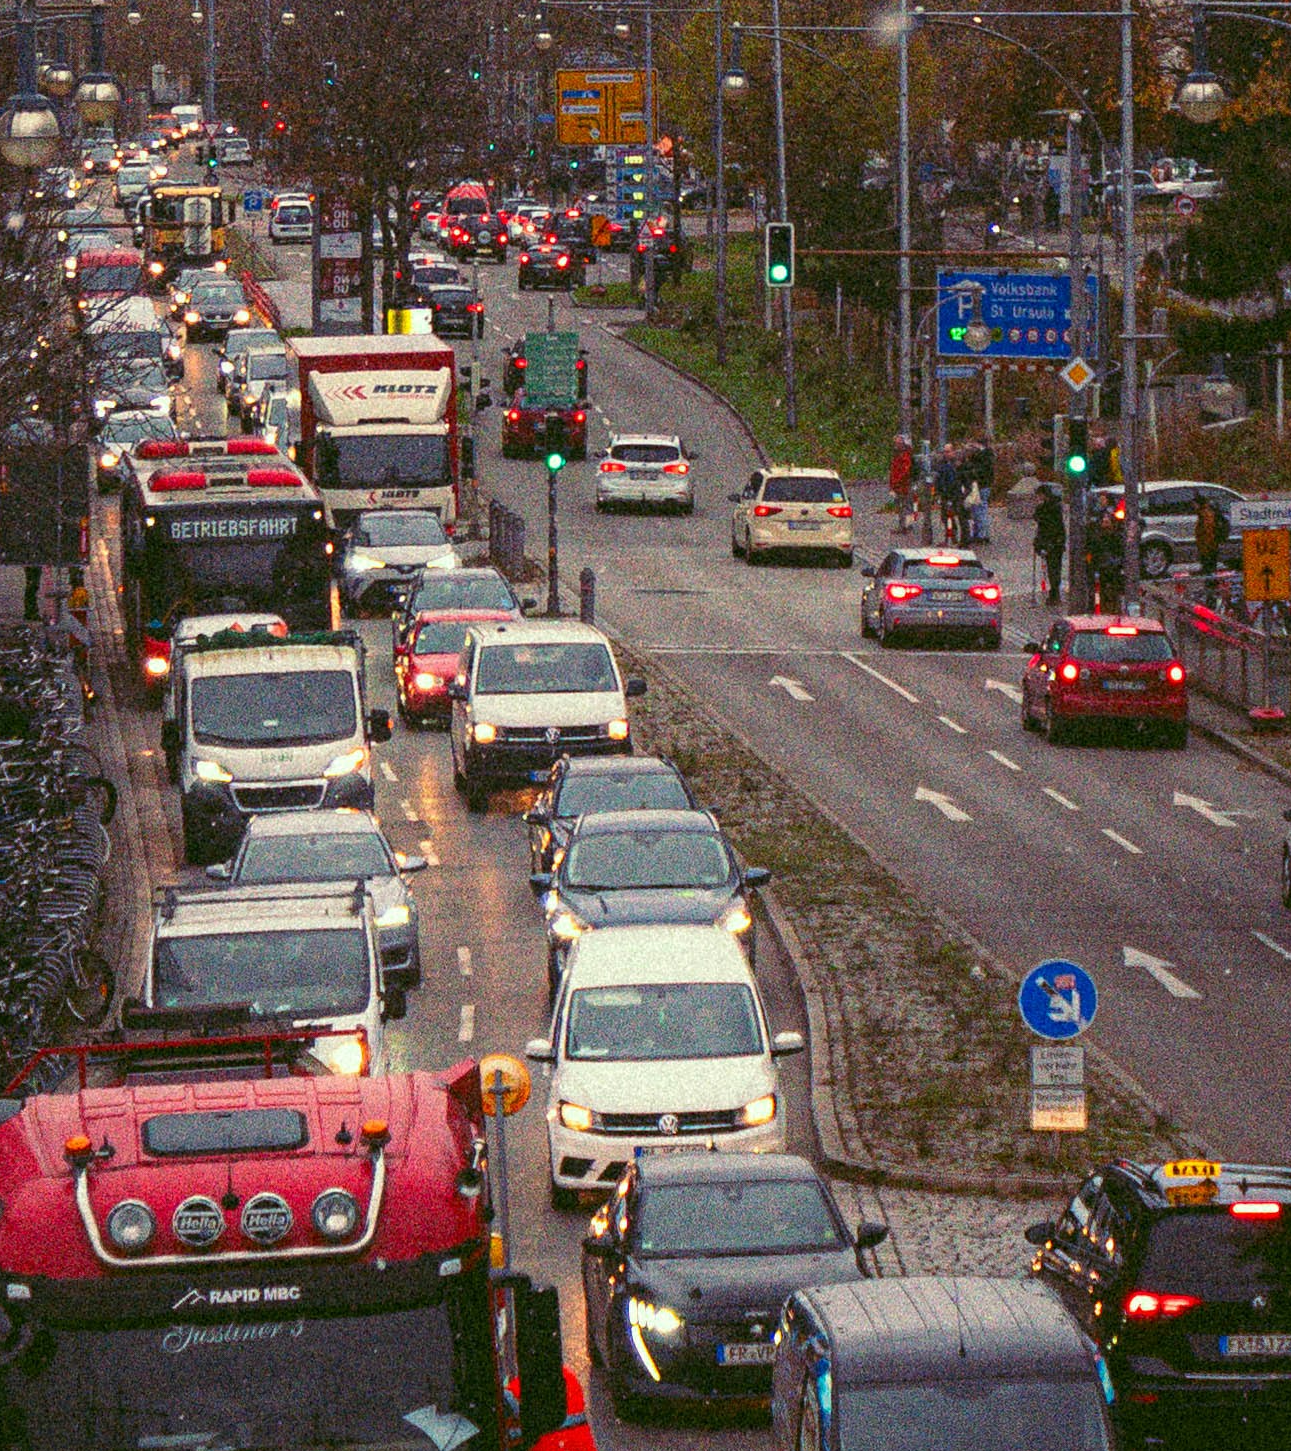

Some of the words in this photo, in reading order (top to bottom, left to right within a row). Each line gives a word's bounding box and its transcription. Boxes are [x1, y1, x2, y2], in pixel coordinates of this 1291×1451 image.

[991, 281, 1058, 297] Volksbank
[373, 384, 439, 394] KLOTZ
[171, 517, 298, 539] BETRIEBSFAHRT
[1256, 538, 1279, 555] U2
[1172, 1165, 1215, 1176] TAXI
[180, 1217, 216, 1230] Hella
[248, 1213, 287, 1227] Hella
[210, 1288, 260, 1304] RAPID
[263, 1286, 301, 1301] MBC
